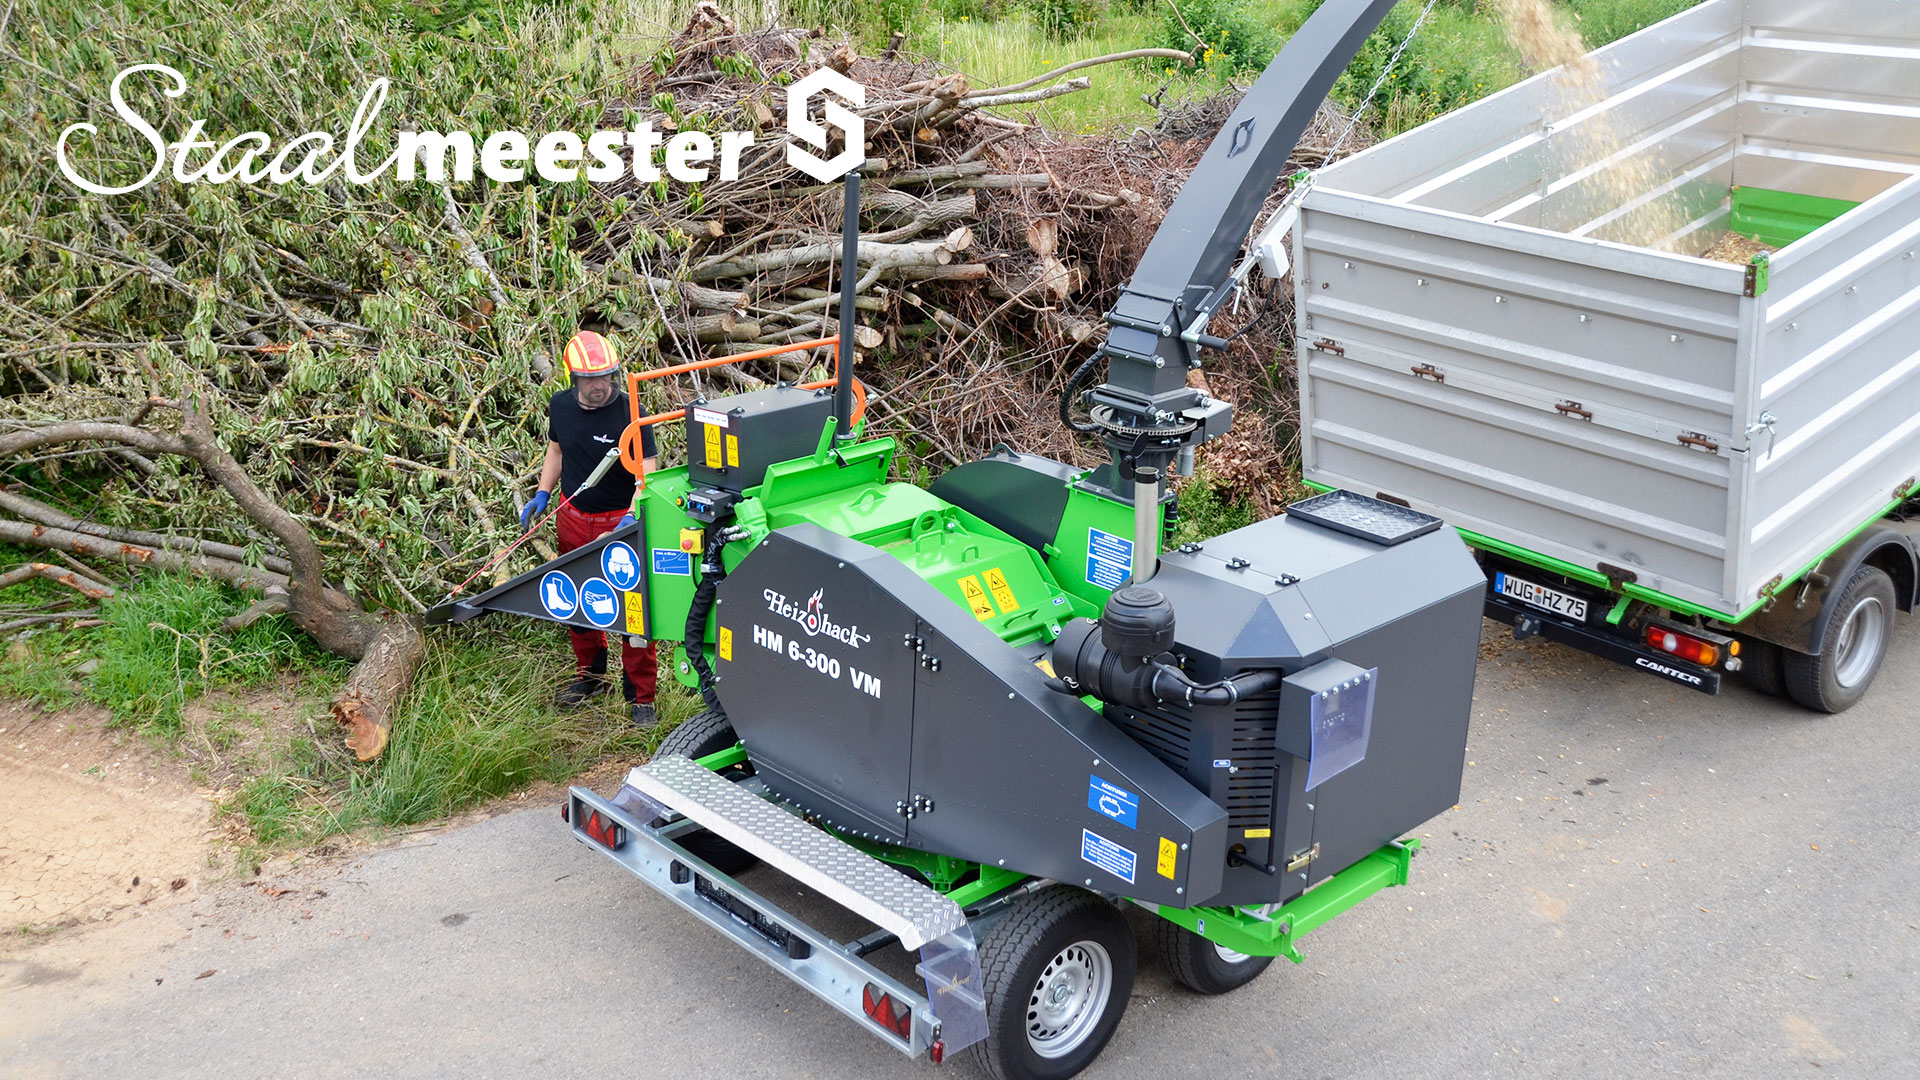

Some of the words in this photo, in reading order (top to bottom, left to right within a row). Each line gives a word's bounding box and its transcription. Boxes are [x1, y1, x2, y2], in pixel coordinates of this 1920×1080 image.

[1504, 577, 1533, 601] WUG
[1542, 589, 1562, 611] HZ
[1566, 597, 1585, 618] 75
[753, 624, 783, 654] HM
[788, 640, 841, 679] 6-300
[849, 666, 881, 699] VM
[1635, 657, 1702, 685] CANTER
